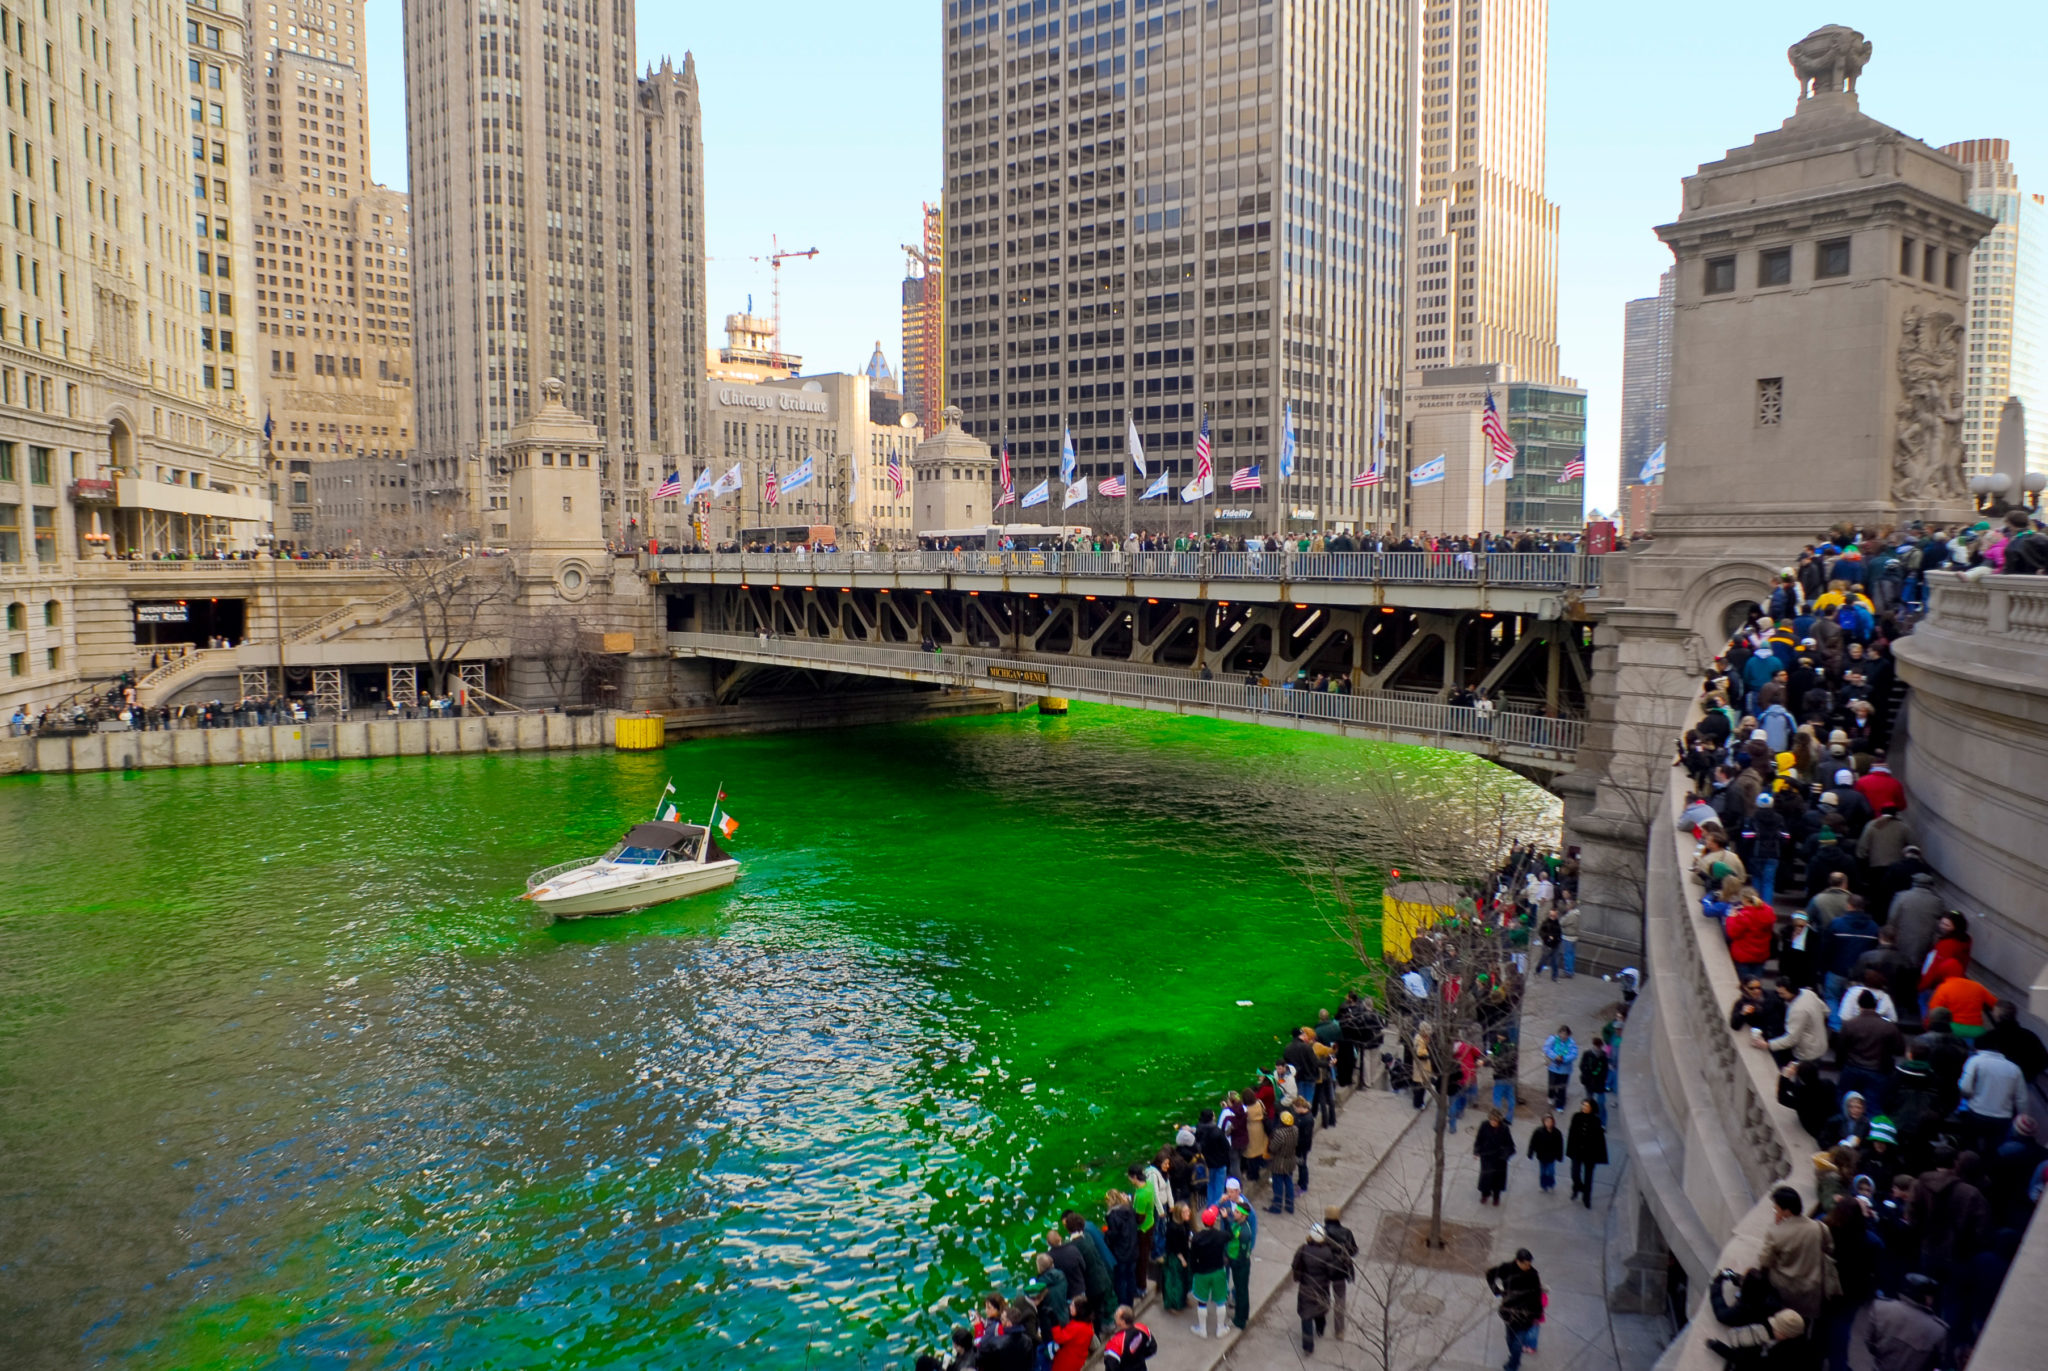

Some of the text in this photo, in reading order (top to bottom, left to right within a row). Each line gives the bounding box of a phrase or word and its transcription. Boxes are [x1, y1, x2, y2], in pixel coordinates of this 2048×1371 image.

[720, 388, 829, 413] Chicago Tribune
[1413, 393, 1455, 401] UNIVERSITY
[1469, 391, 1502, 399] CHICGO
[1222, 509, 1252, 519] Fidelity
[990, 667, 1047, 683] MICHIGAN AVENUE
